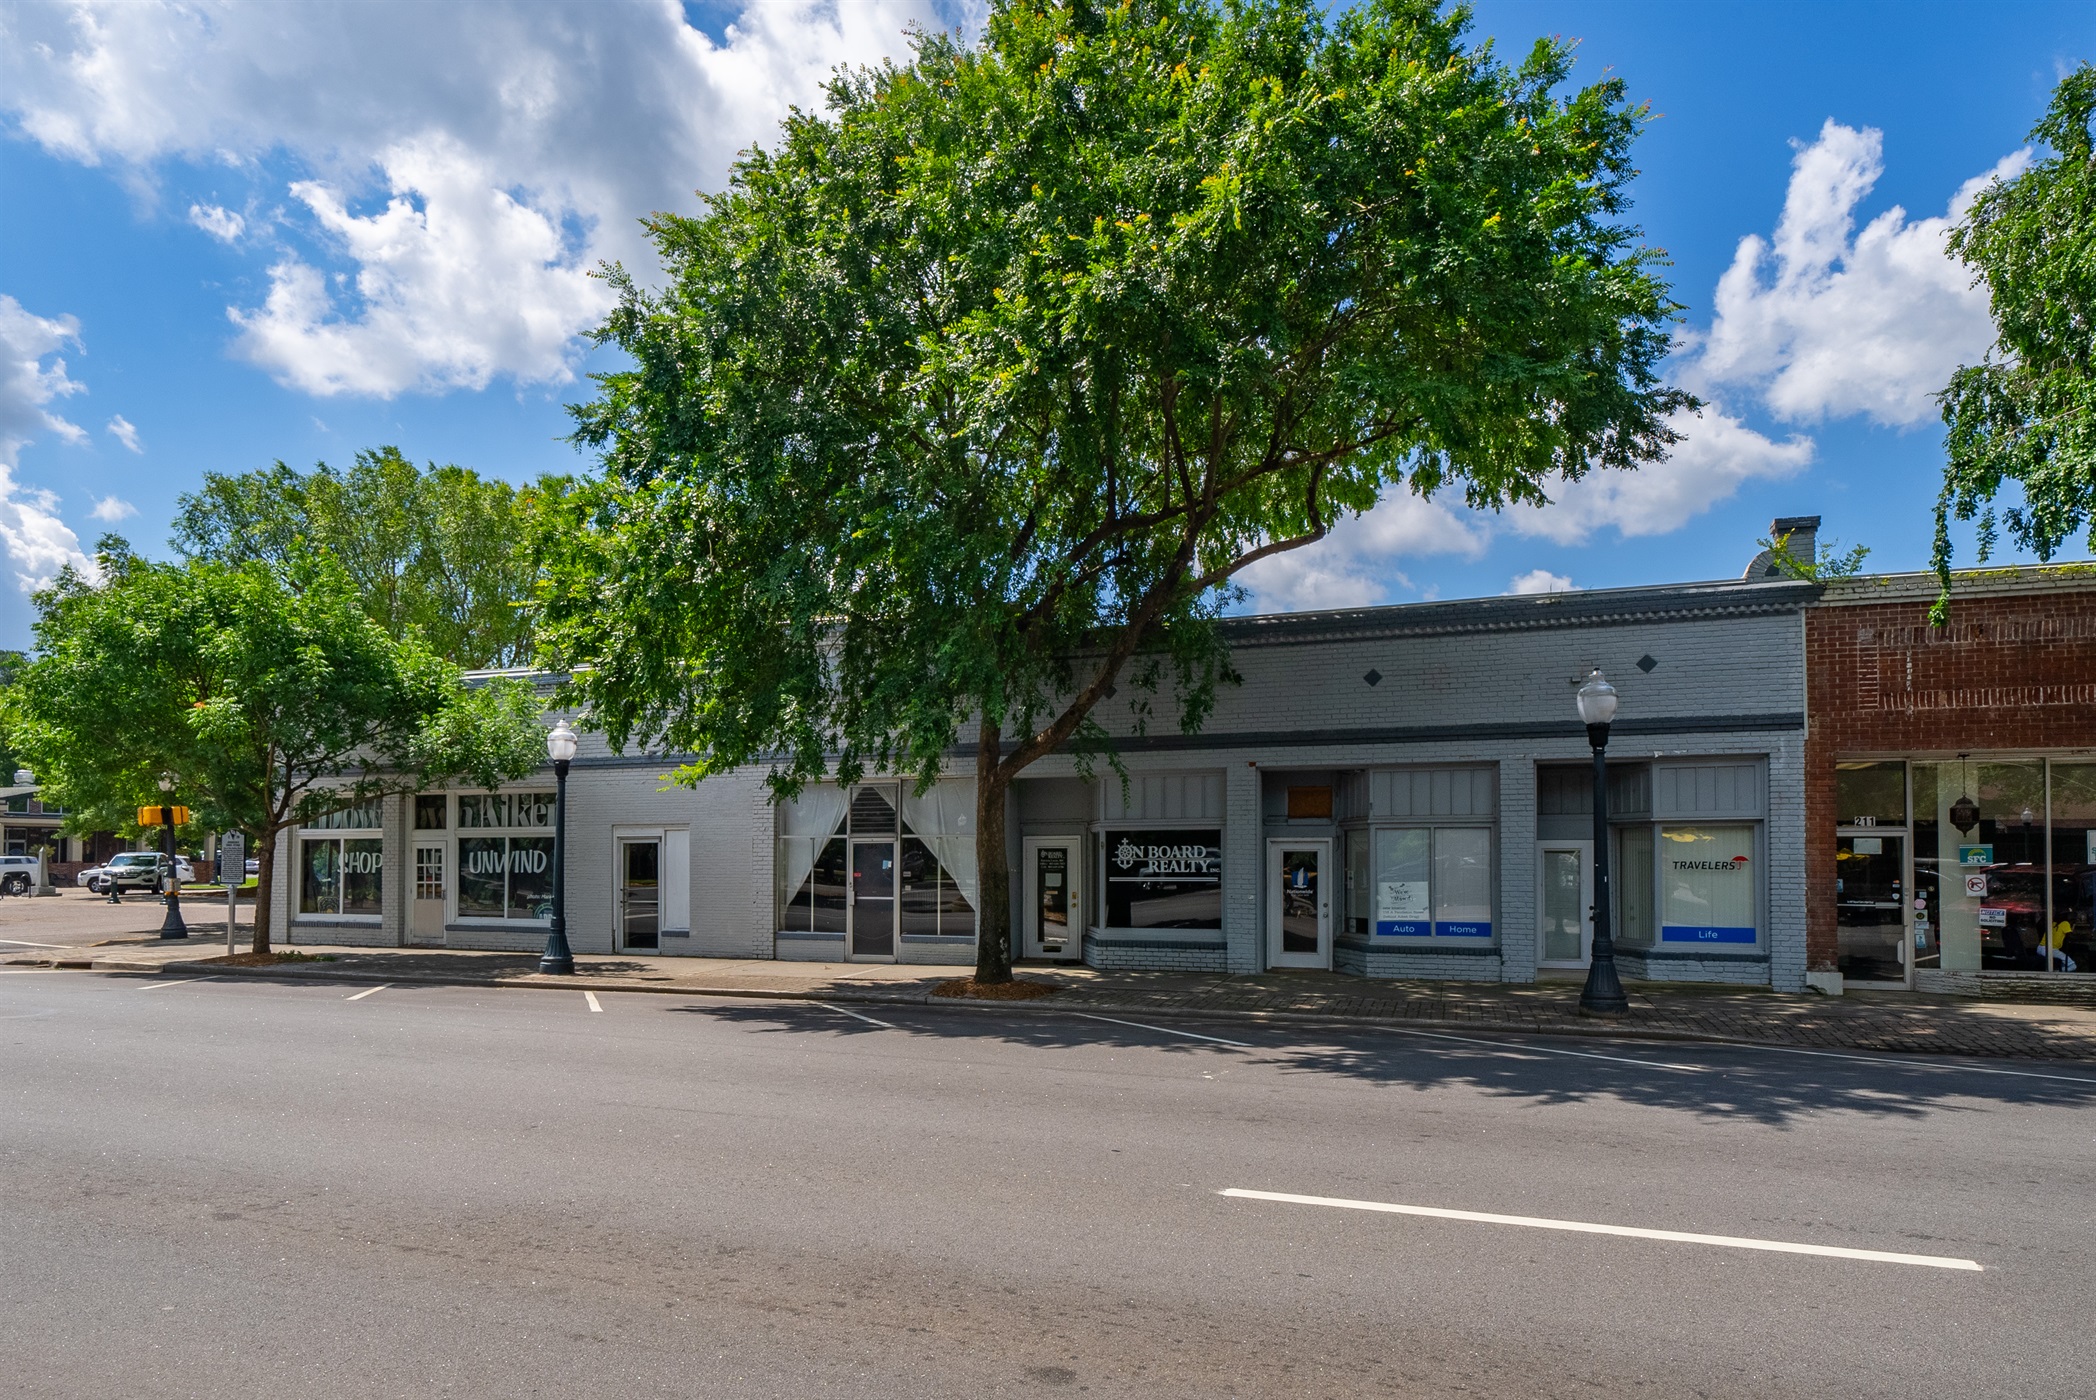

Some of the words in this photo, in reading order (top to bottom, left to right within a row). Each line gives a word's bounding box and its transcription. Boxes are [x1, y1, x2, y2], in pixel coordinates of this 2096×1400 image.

[1856, 816, 1874, 826] 211
[1147, 845, 1207, 859] BOARD
[337, 851, 383, 874] SHOP
[468, 849, 547, 874] UNWIND
[1149, 860, 1211, 873] REALTY
[1672, 861, 1736, 870] TRAVELERS
[1393, 925, 1415, 933] Auto
[1449, 925, 1477, 934] Home
[1698, 930, 1718, 939] Life
